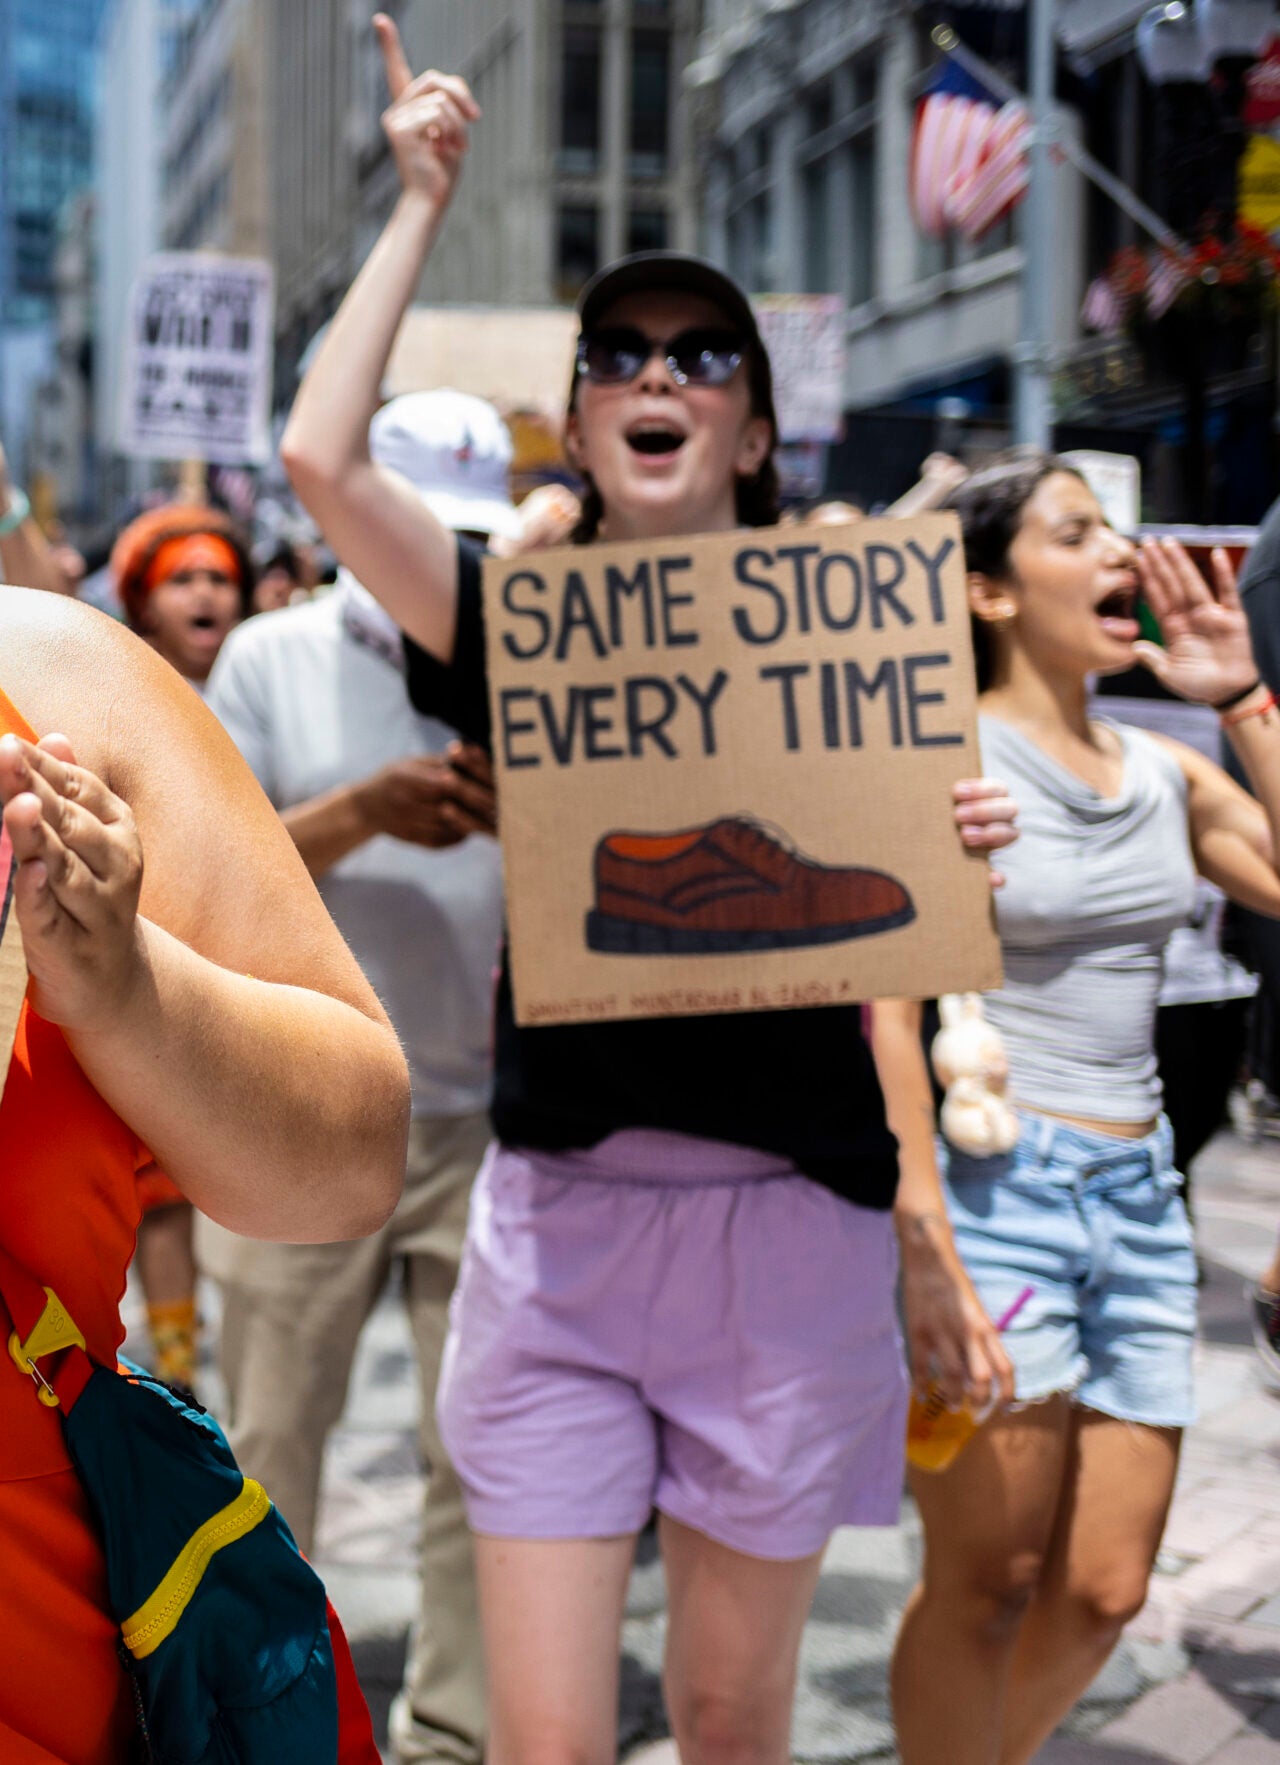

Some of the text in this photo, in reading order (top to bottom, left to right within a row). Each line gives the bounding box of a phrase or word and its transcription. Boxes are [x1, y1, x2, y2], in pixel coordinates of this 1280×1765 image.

[502, 538, 956, 661] SAME STORY
[500, 654, 964, 769] EVERY TIME
